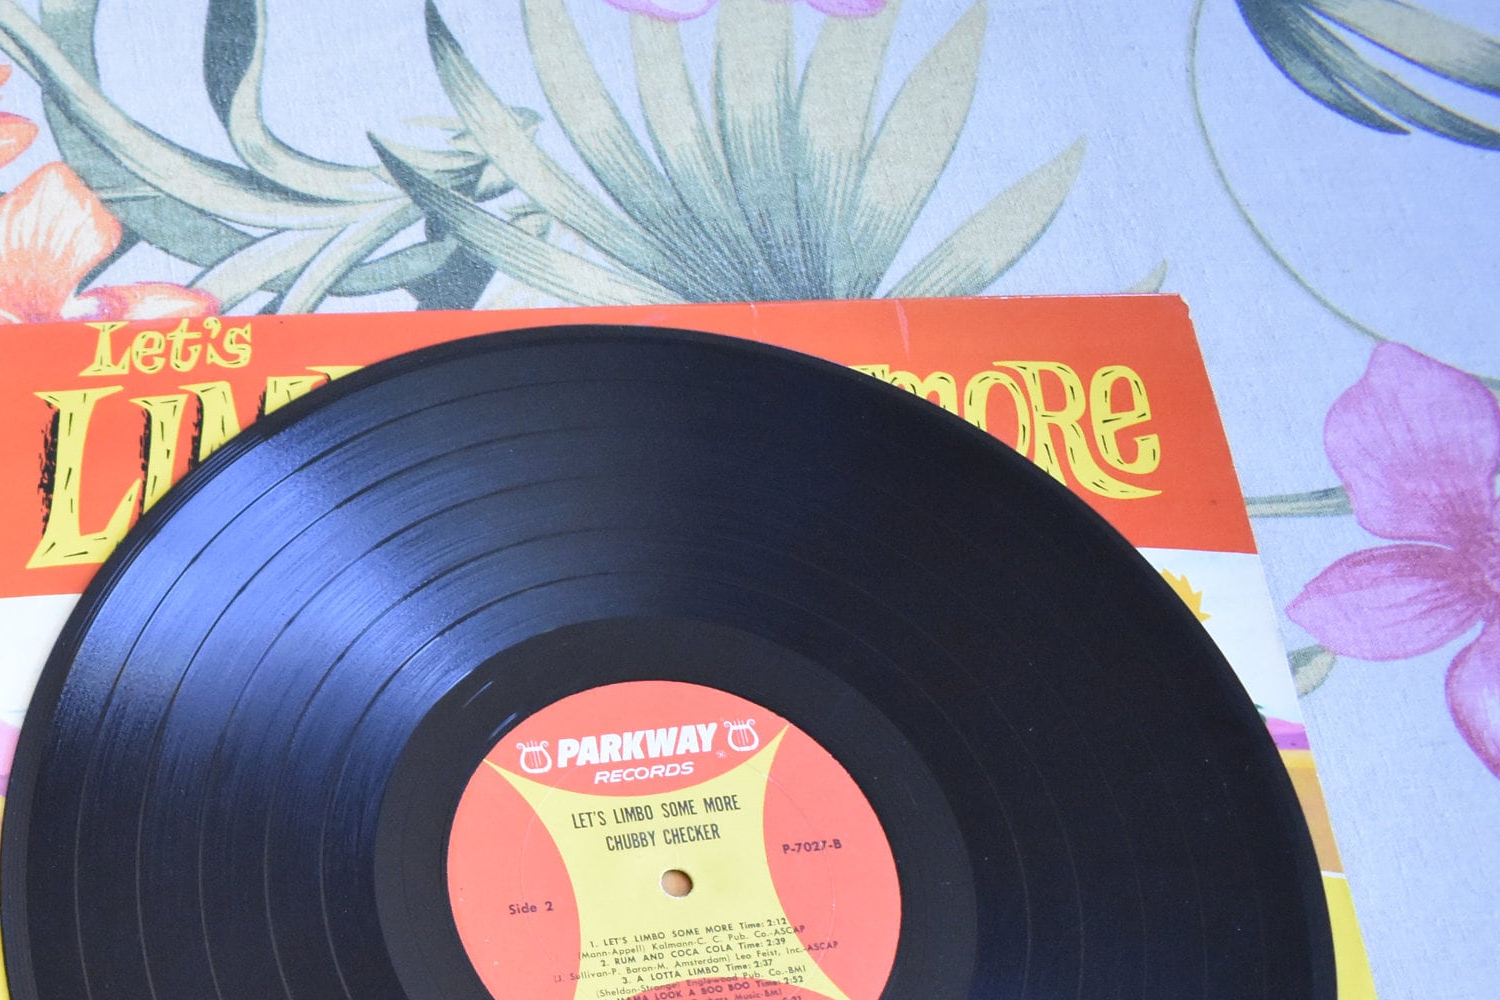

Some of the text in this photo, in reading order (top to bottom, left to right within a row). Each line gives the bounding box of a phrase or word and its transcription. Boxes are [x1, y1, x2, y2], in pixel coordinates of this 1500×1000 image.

[78, 317, 252, 376] Let's
[556, 720, 718, 769] PARKWAY
[593, 760, 694, 785] RECORDS
[571, 793, 740, 829] LET'S LIMBO SOME MORE
[605, 822, 720, 852] CHUBBY CHECKER
[782, 838, 841, 854] P-7027-B
[508, 900, 554, 914] Side 2
[602, 937, 628, 946] LET'S
[634, 932, 665, 942] LIMBO
[672, 928, 700, 938] SOME
[705, 924, 733, 934] MORE
[738, 920, 764, 930] Time:
[766, 917, 786, 926] 2:12
[614, 956, 636, 965] RUM
[642, 952, 664, 961] AND
[670, 948, 699, 958] COCA
[705, 944, 732, 954] COLA
[738, 940, 763, 950] Time:
[765, 937, 785, 946] 2:39
[735, 951, 751, 961] Leo
[650, 970, 681, 981] LOTTA
[688, 966, 718, 976] LIMBO
[725, 962, 751, 972] Time:
[753, 959, 772, 968] 2:37
[654, 990, 682, 1000] LOOK
